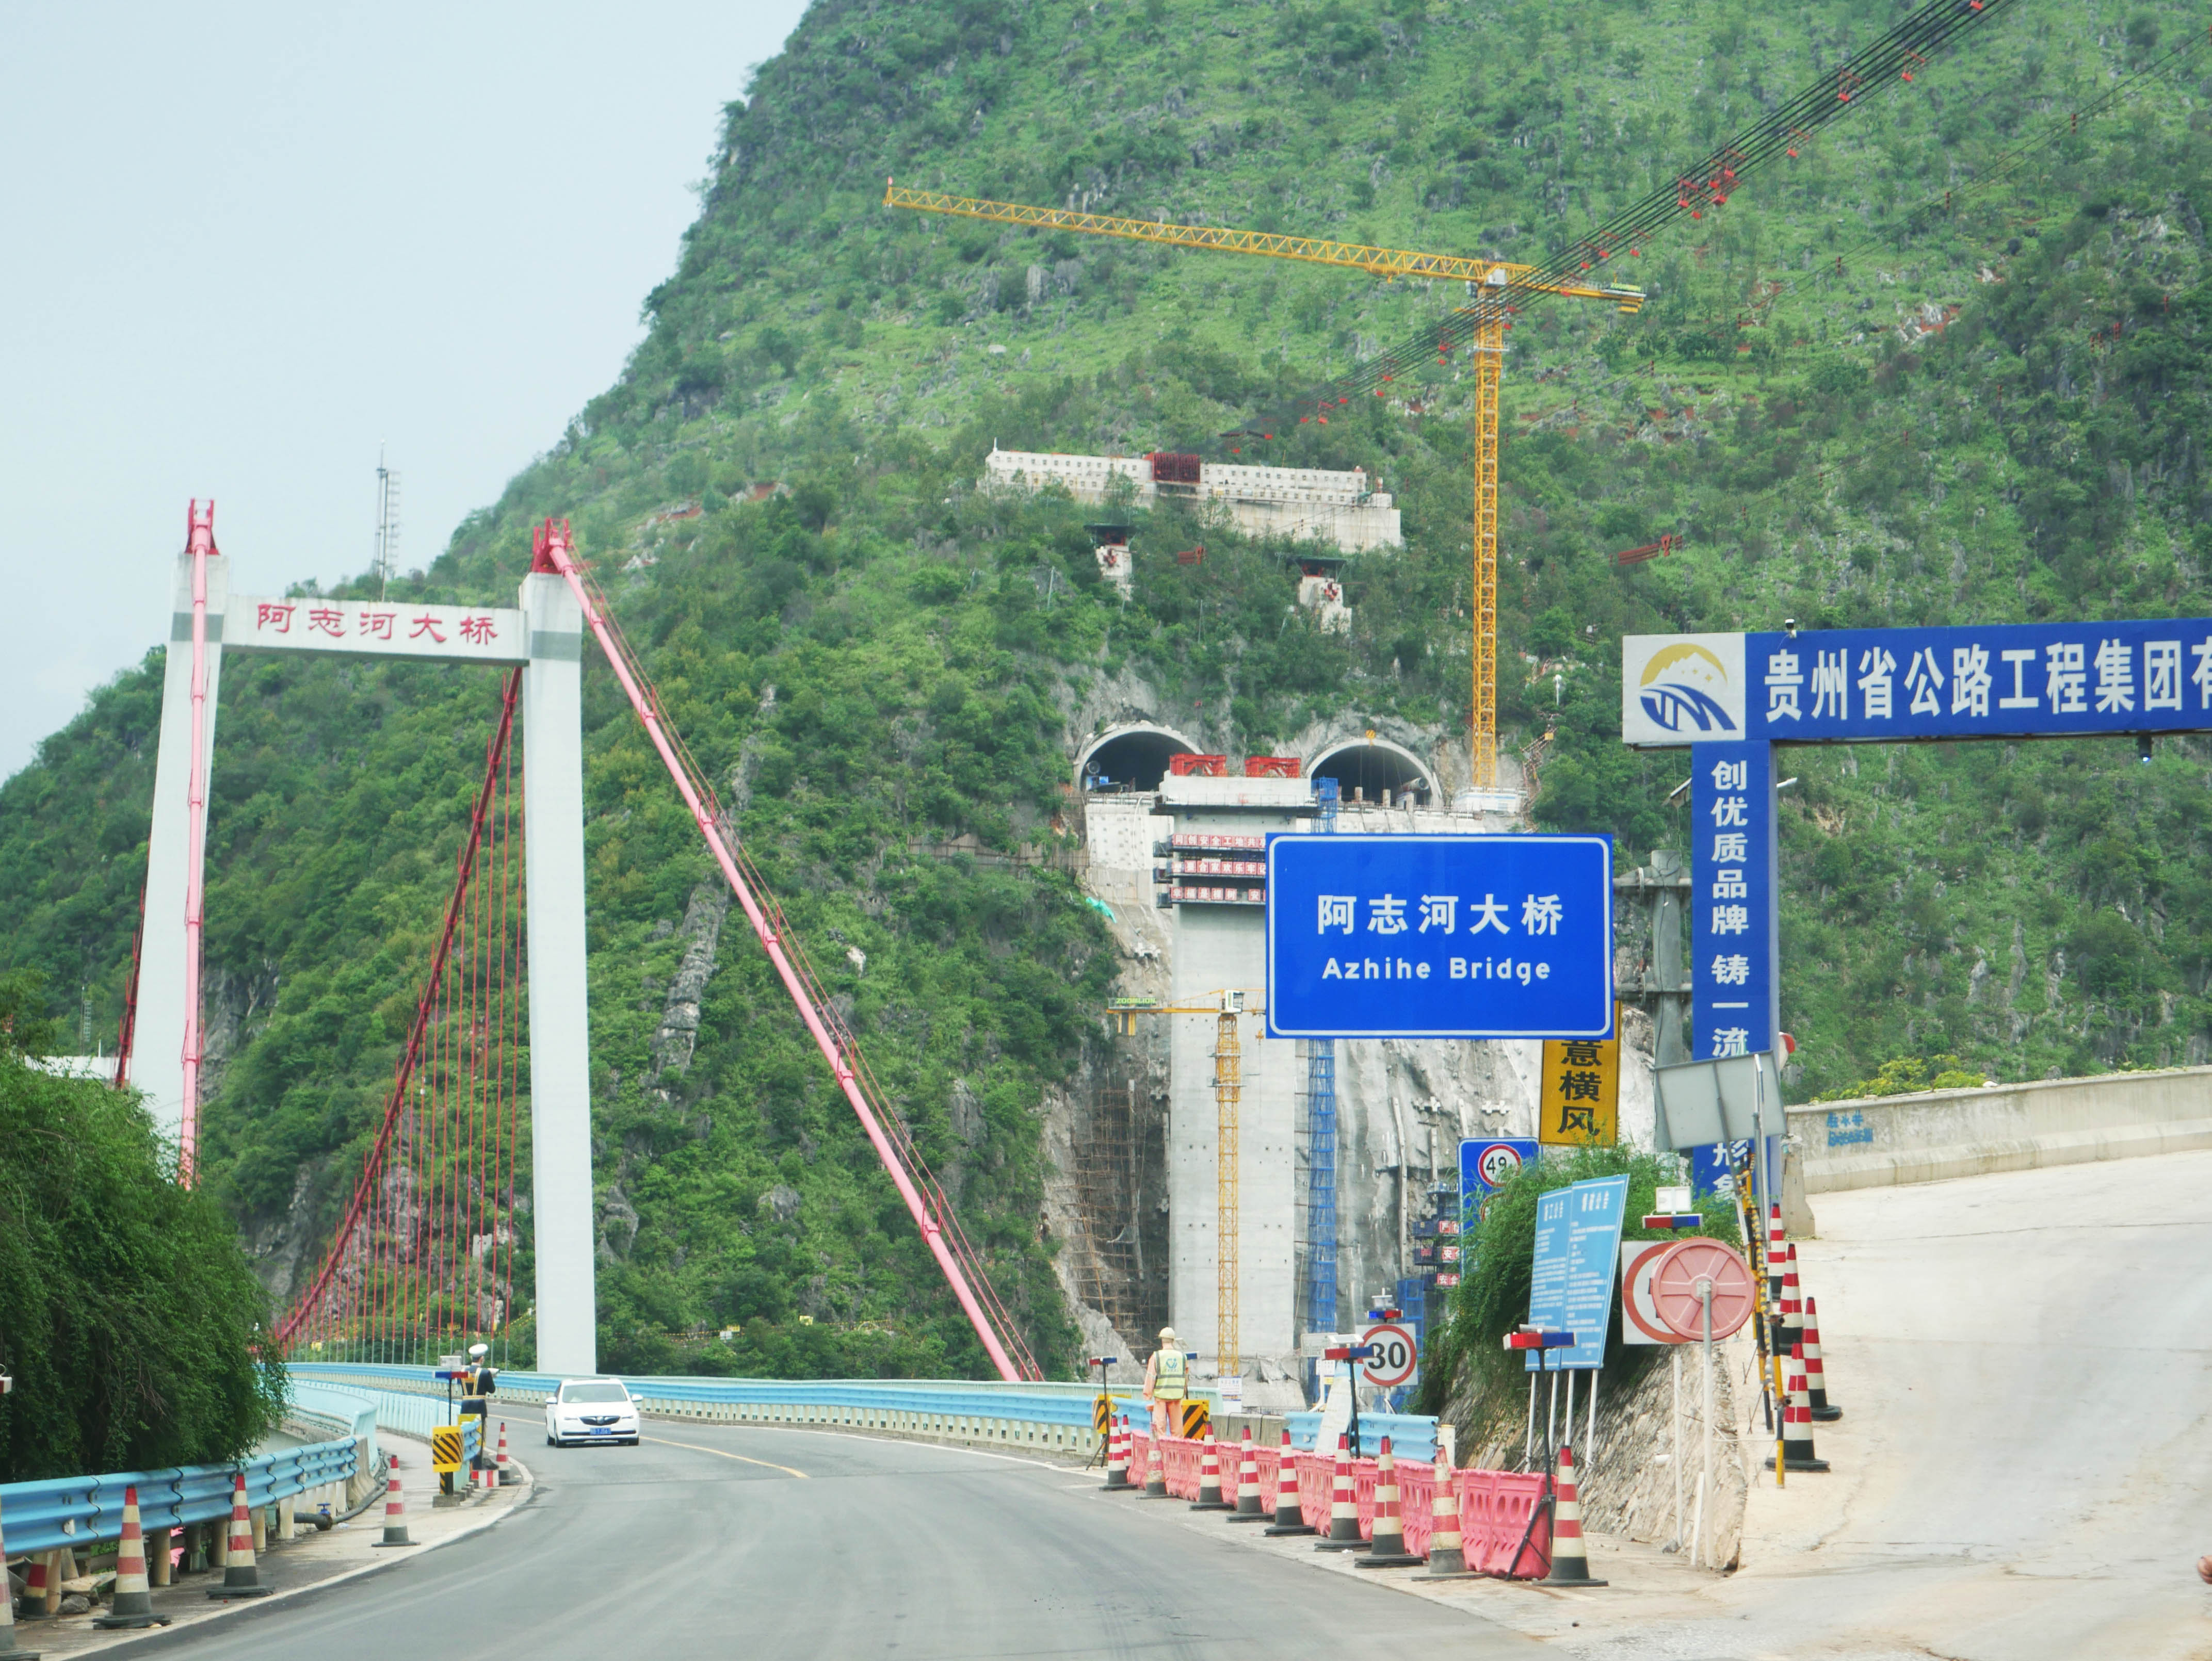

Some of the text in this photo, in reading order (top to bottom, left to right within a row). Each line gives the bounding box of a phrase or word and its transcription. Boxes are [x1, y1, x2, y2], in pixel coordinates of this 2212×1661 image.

[257, 604, 498, 645] 阿志河大桥
[1765, 636, 2212, 723] 贵州省公路工程集团有
[1711, 760, 1748, 935] 创优质品牌
[1317, 893, 1563, 935] 阿志河大桥
[1322, 957, 1551, 986] Azhihe Bridge
[1557, 1040, 1603, 1136] 意横风
[1368, 1342, 1406, 1369] 30
